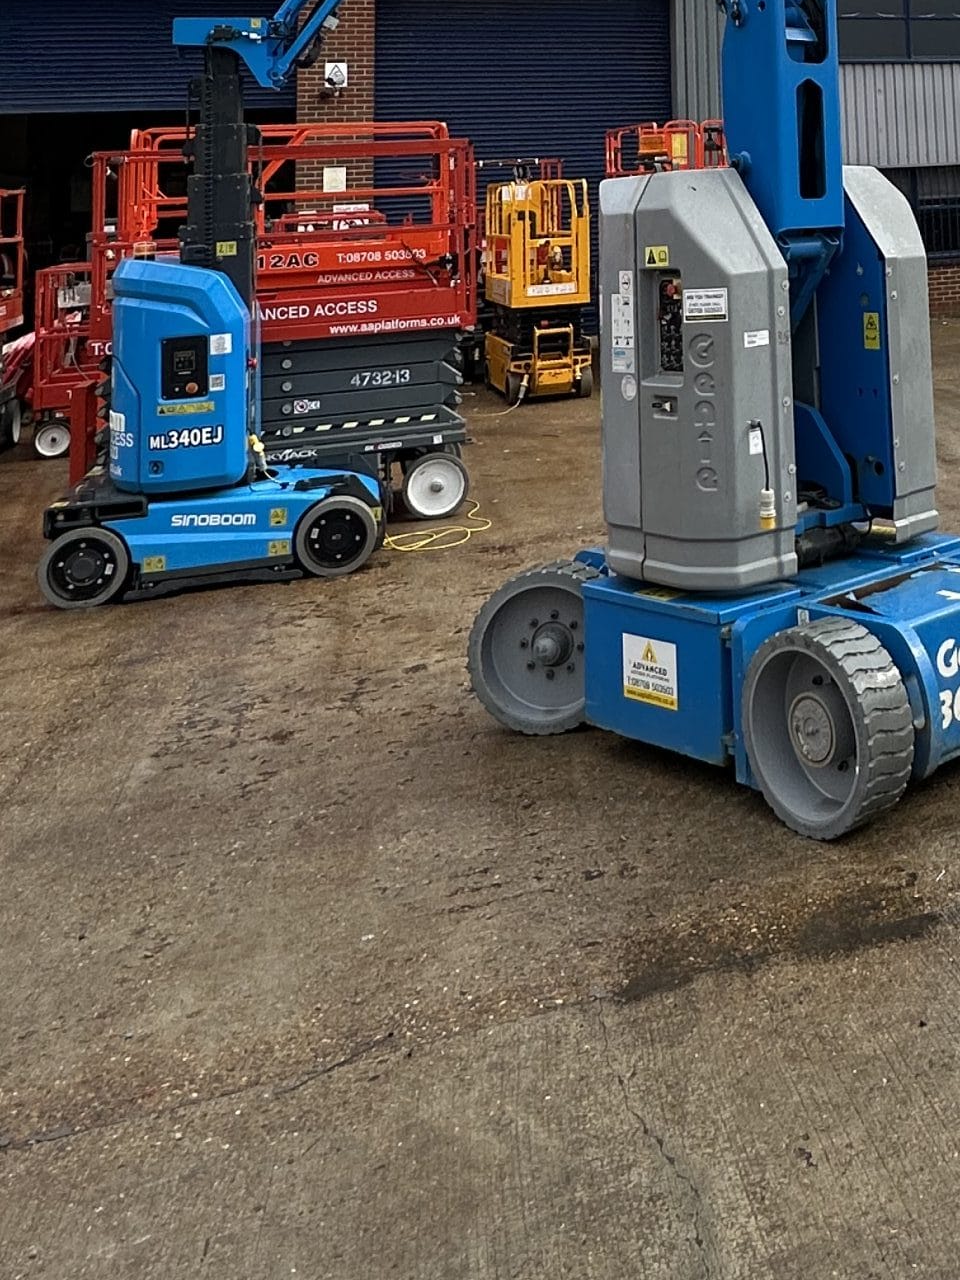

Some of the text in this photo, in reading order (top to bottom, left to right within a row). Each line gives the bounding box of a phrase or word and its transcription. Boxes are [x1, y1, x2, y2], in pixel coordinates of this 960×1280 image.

[336, 251, 382, 264] T:08708
[317, 269, 415, 284] ADVANCED ACCESS
[313, 300, 378, 317] ACCESS
[329, 315, 461, 334] www.aaplatforms.co.uk
[350, 369, 411, 387] 473213
[150, 426, 223, 450] ML340EJ
[265, 448, 318, 461] KYJACK
[171, 513, 257, 527] SINOBOOM
[632, 661, 668, 677] ADVANCED
